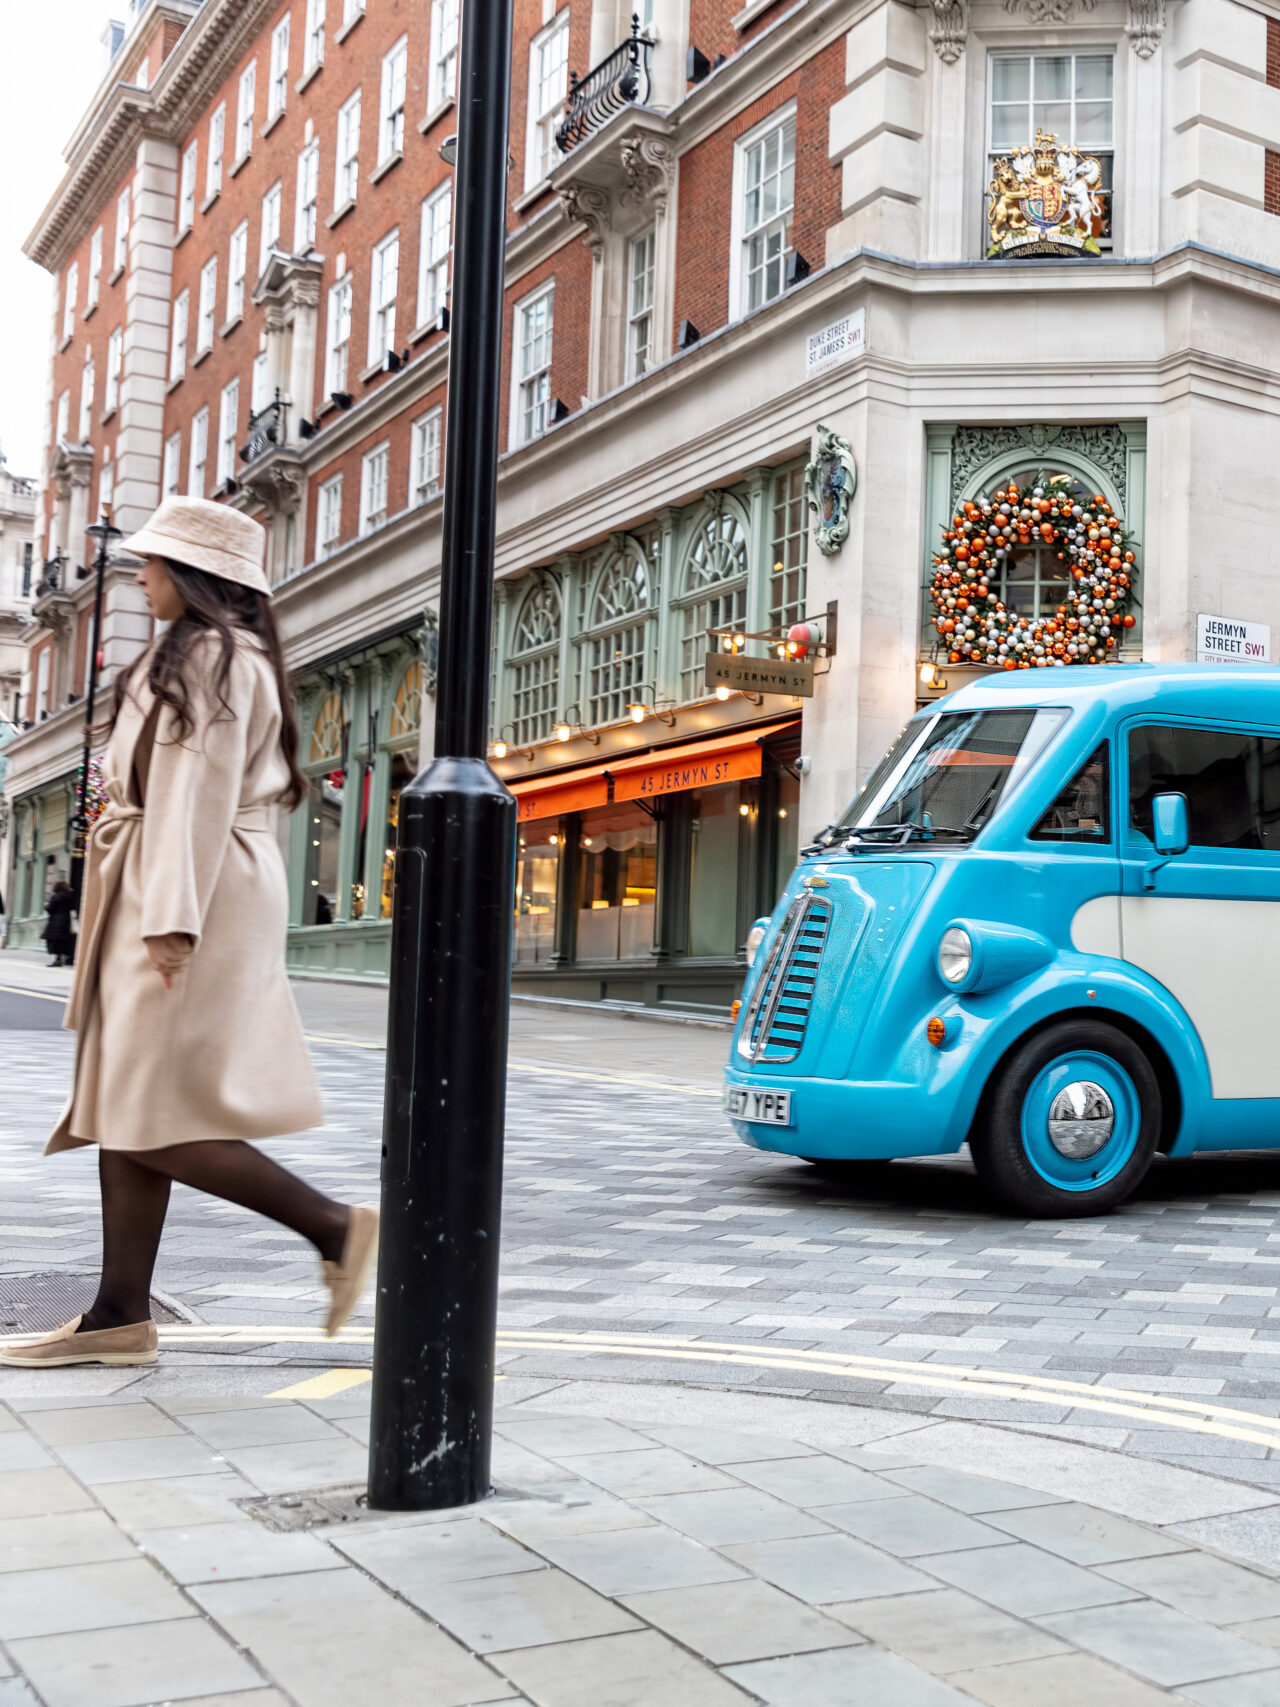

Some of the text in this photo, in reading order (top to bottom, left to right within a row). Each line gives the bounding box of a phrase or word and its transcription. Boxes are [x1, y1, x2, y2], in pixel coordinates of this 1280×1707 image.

[809, 319, 850, 350] DUKE STREET
[847, 328, 861, 345] SW1
[1205, 620, 1247, 639] JERMYN
[1205, 635, 1265, 657] STREET SW1
[716, 670, 806, 687] 45 JERMYN ST
[640, 776, 654, 793] 45
[659, 765, 708, 791] JERMYN
[752, 1092, 787, 1121] YPE
